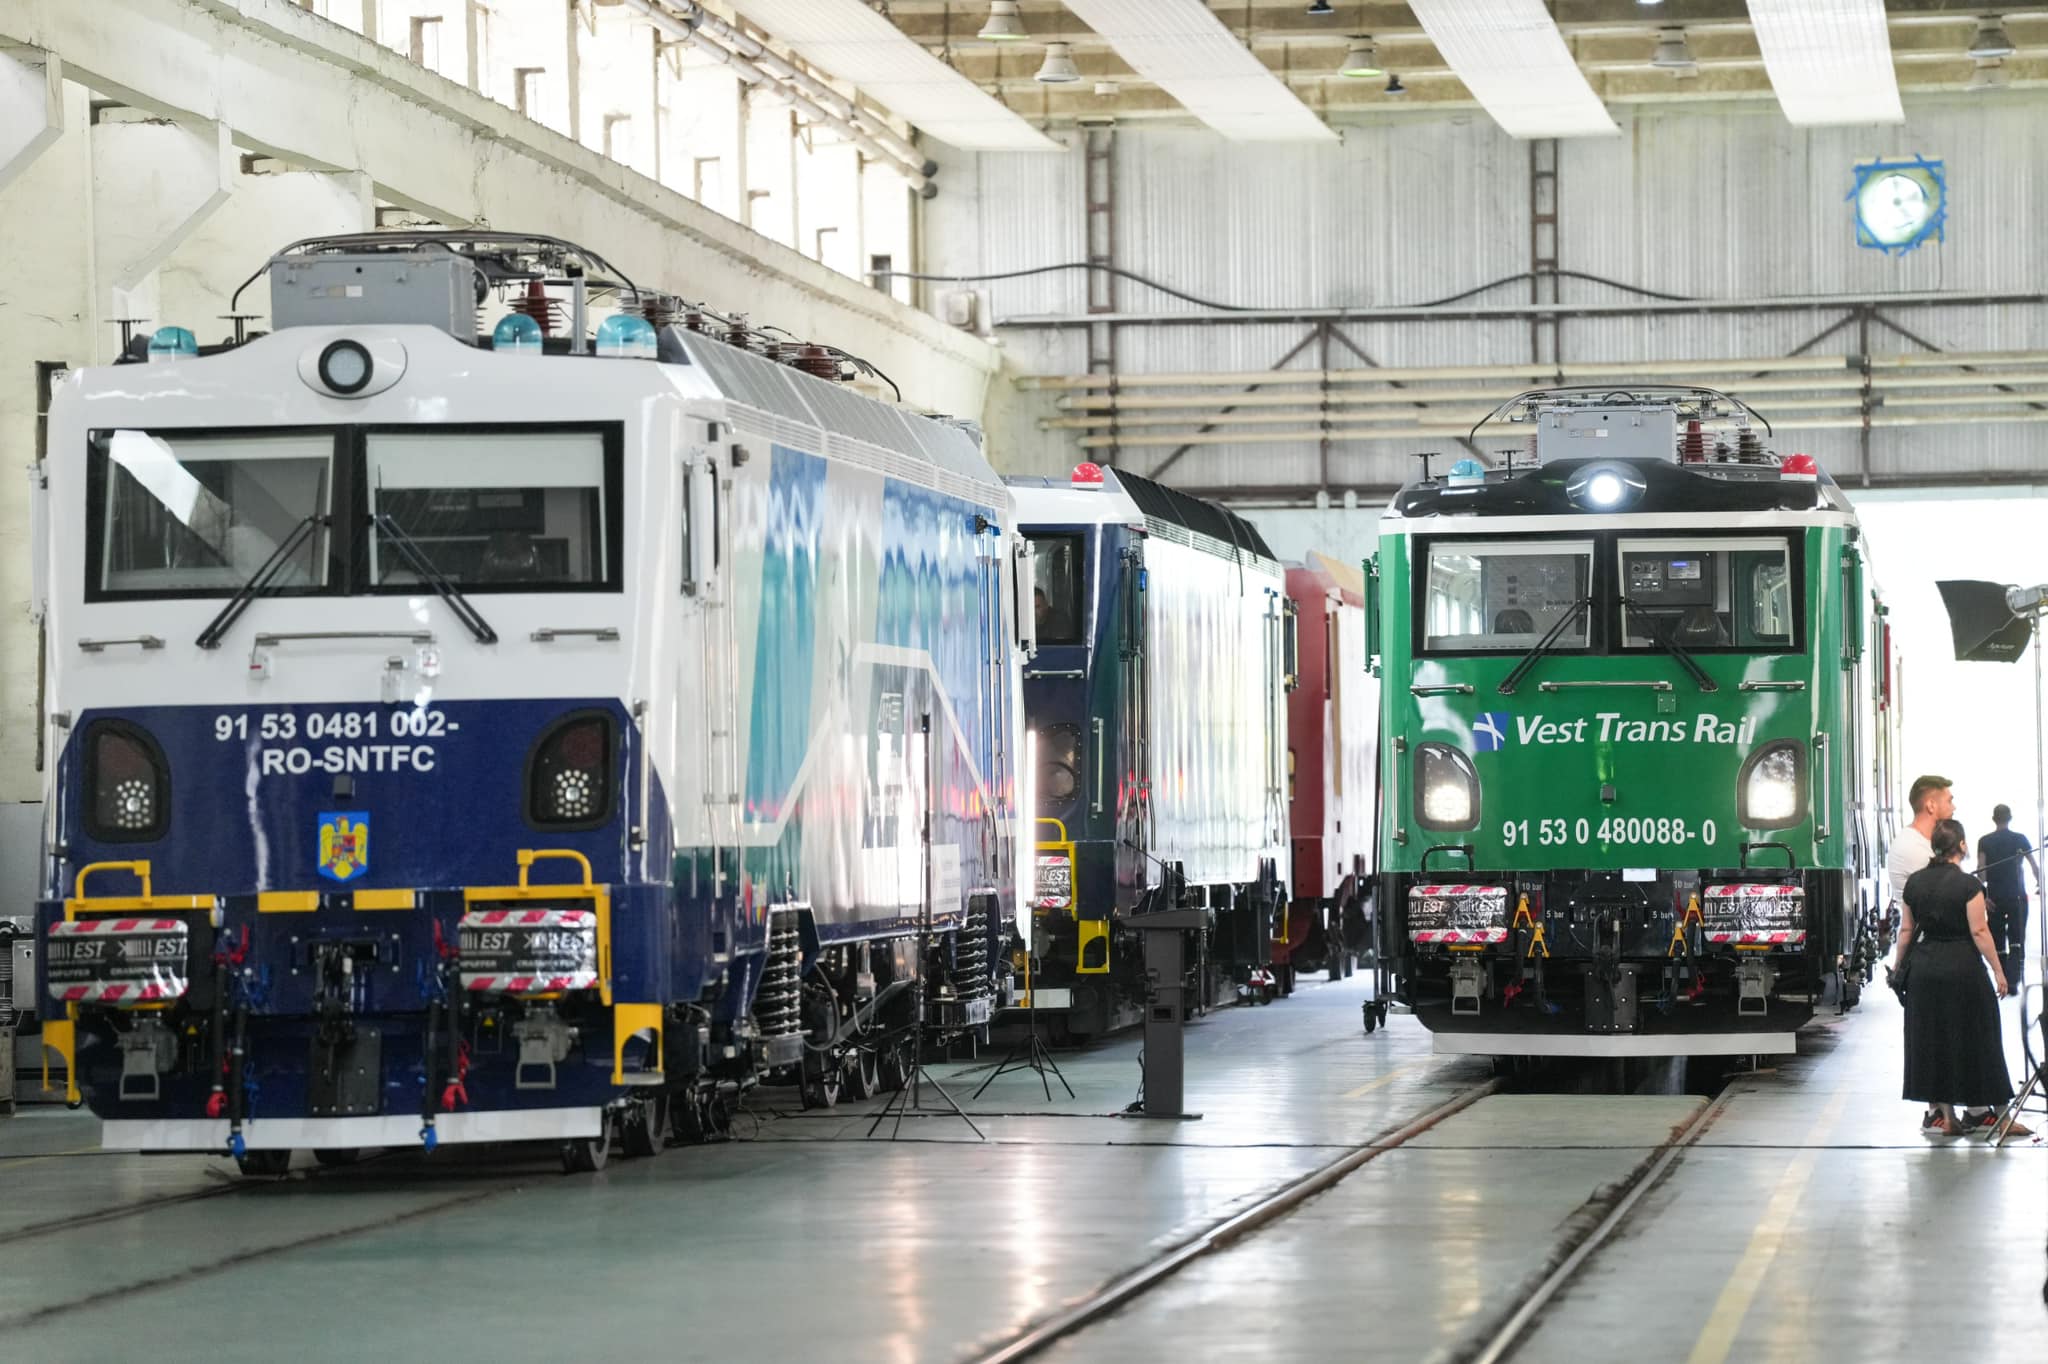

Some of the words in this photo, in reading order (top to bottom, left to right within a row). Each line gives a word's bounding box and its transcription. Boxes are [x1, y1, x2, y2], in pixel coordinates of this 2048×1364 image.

[215, 714, 248, 740] 91
[261, 712, 297, 739] 53
[306, 711, 378, 739] 0481
[390, 710, 460, 737] 002-
[1515, 714, 1588, 745] Vest
[1595, 712, 1687, 743] Trans
[1693, 713, 1757, 745] Rail
[262, 745, 435, 775] RO-SNTFC
[1502, 819, 1529, 847] 91
[1539, 818, 1568, 845] 53
[1575, 817, 1590, 845] 0
[1597, 816, 1696, 845] 480088-
[1702, 818, 1717, 846] 0
[1522, 882, 1531, 890] 10
[1532, 882, 1543, 891] bar
[1673, 880, 1683, 889] 10
[1684, 880, 1695, 889] bar
[1554, 910, 1564, 919] bar
[73, 941, 107, 959] EST
[154, 938, 187, 956] EST
[480, 932, 513, 950] EST
